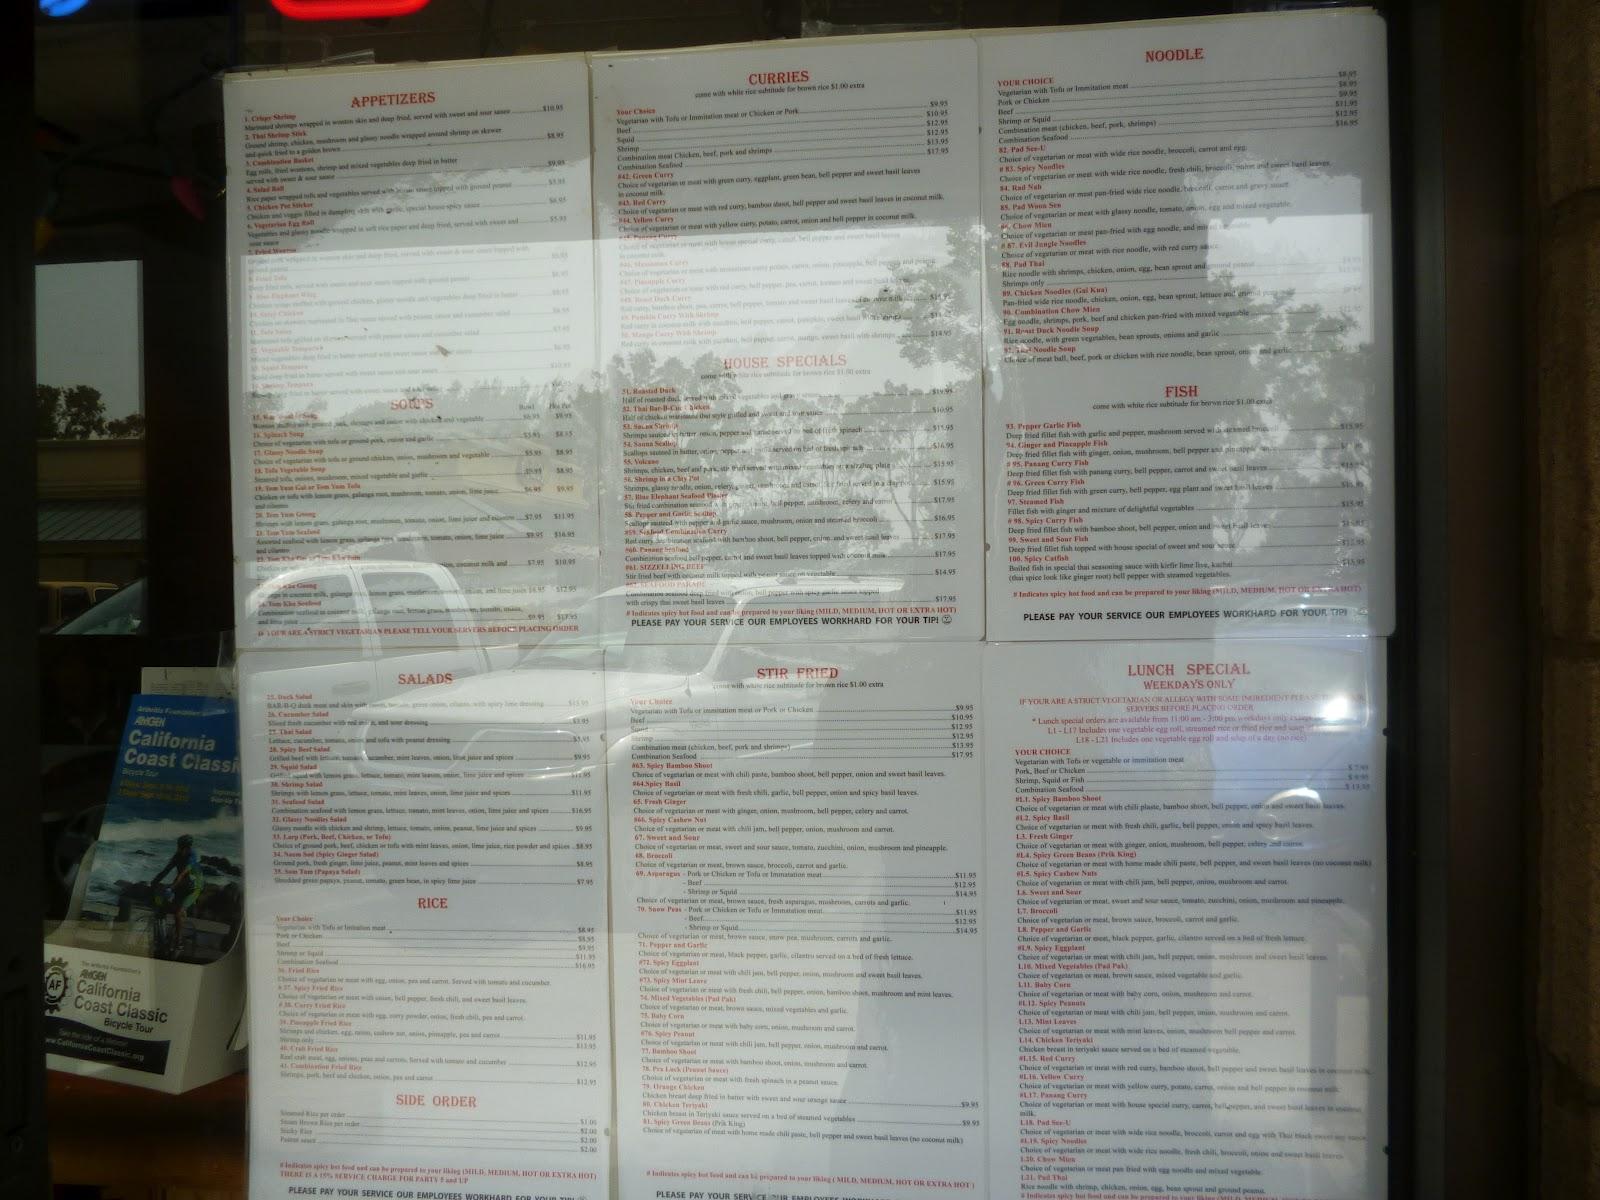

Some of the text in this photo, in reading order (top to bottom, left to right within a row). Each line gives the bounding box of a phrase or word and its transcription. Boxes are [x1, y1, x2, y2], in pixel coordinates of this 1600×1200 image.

[1145, 48, 1206, 63] NOODLE
[748, 71, 810, 85] CURRIES
[996, 88, 1032, 98] Vegetarian
[1032, 86, 1048, 94] with
[1049, 85, 1065, 93] Tofu
[351, 92, 436, 108] APPETIZERS
[997, 98, 1013, 106] Pork
[615, 117, 649, 126] Vegetarian
[748, 109, 775, 117] Chicken
[783, 107, 799, 115] Pork
[616, 135, 635, 144] Squid
[998, 135, 1041, 144] Combination
[617, 145, 639, 153] Shrimp
[617, 163, 657, 171] Combination
[724, 354, 847, 369] HOUSE SPECIALS
[1165, 385, 1198, 398] FISH
[390, 398, 434, 410] SOUPS
[1007, 507, 1025, 515] Fillet
[1056, 507, 1077, 515] ginger
[1127, 504, 1159, 513] delightful
[1159, 504, 1194, 513] vegetables
[1023, 612, 1054, 621] PLEASE
[1058, 612, 1075, 620] PAY
[1078, 612, 1103, 620] YOUR
[1106, 611, 1142, 620] SERVICE
[1145, 611, 1165, 619] OUR
[1169, 610, 1219, 619] EMPLOYEES
[1223, 609, 1276, 618] WORKHARD
[1280, 609, 1297, 617] FOR
[1301, 608, 1326, 617] YOUR
[631, 619, 661, 627] PLEASE
[665, 618, 680, 626] PAY
[683, 618, 707, 626] YOUR
[710, 618, 744, 626] SERVICE
[747, 617, 766, 626] OUR
[770, 617, 818, 625] EMPLOYEES
[821, 616, 871, 625] WORKHARD
[875, 616, 892, 624] FOR
[895, 616, 919, 624] YOUR
[757, 667, 838, 679] STIR FRIED
[1128, 663, 1251, 676] LUNCH SPECIAL
[398, 673, 454, 685] SALADS
[1143, 678, 1236, 690] WEEKDAYS ONLY
[128, 729, 216, 752] California
[124, 748, 177, 768] Coast
[1014, 758, 1049, 767] Vegetarian
[1049, 757, 1065, 765] with
[1090, 756, 1122, 765] vegetable
[646, 762, 665, 770] Spicy
[1015, 777, 1040, 785] Shrimp,
[1042, 776, 1061, 785] Squid
[418, 897, 448, 909] RICE
[48, 979, 62, 991] AF
[76, 980, 142, 1002] California
[74, 995, 168, 1024] Coast Classic
[103, 1017, 154, 1034] Bicycle Tour
[396, 1094, 477, 1108] SIDE ORDER
[289, 1186, 316, 1195] PLEASE
[337, 1188, 359, 1196] YOUR
[362, 1189, 393, 1198] SERVICE
[396, 1190, 414, 1198] OUR
[417, 1191, 461, 1200] EMPLOYEES
[656, 1190, 731, 1200] PLEASE PAY YOUR
